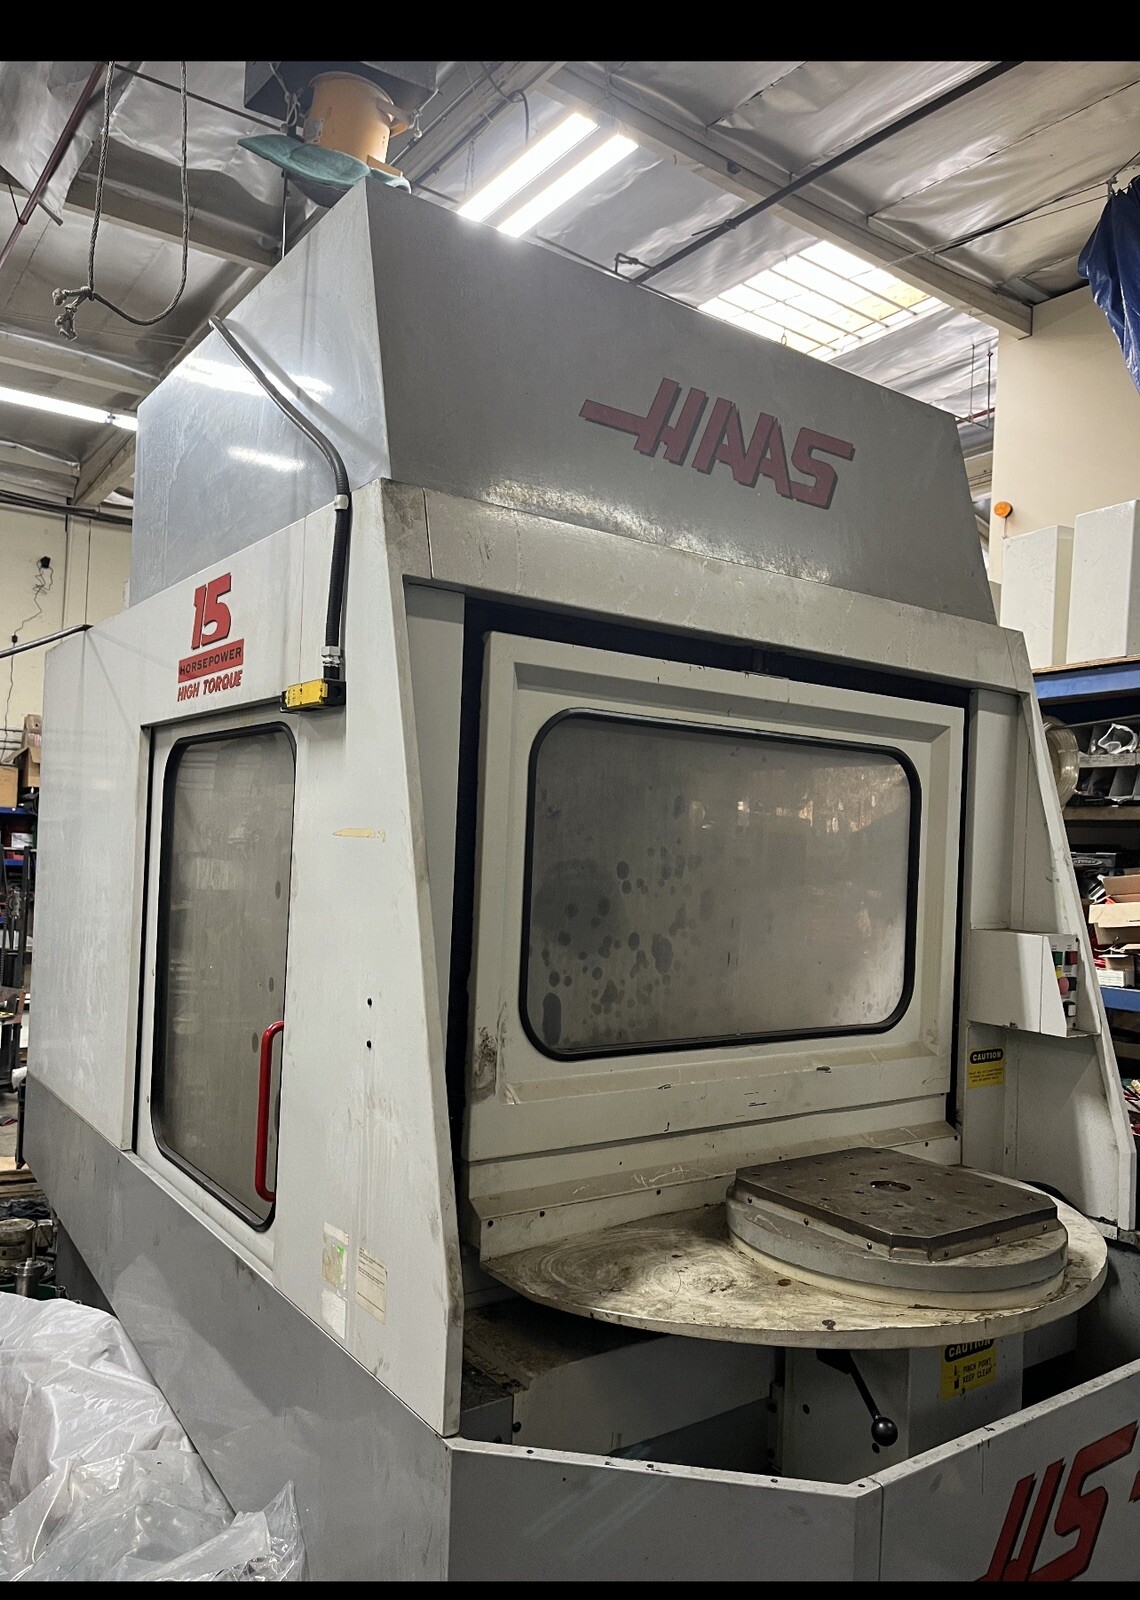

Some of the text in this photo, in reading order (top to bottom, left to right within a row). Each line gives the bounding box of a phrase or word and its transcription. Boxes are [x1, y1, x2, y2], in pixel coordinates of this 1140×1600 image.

[579, 377, 856, 510] HAAS
[191, 572, 232, 650] 15
[179, 646, 242, 675] HORSEPOWER
[177, 669, 243, 702] HIGH TORQUE
[972, 1050, 1002, 1062] CAUTION
[962, 1366, 992, 1383] KEEP CLEAR
